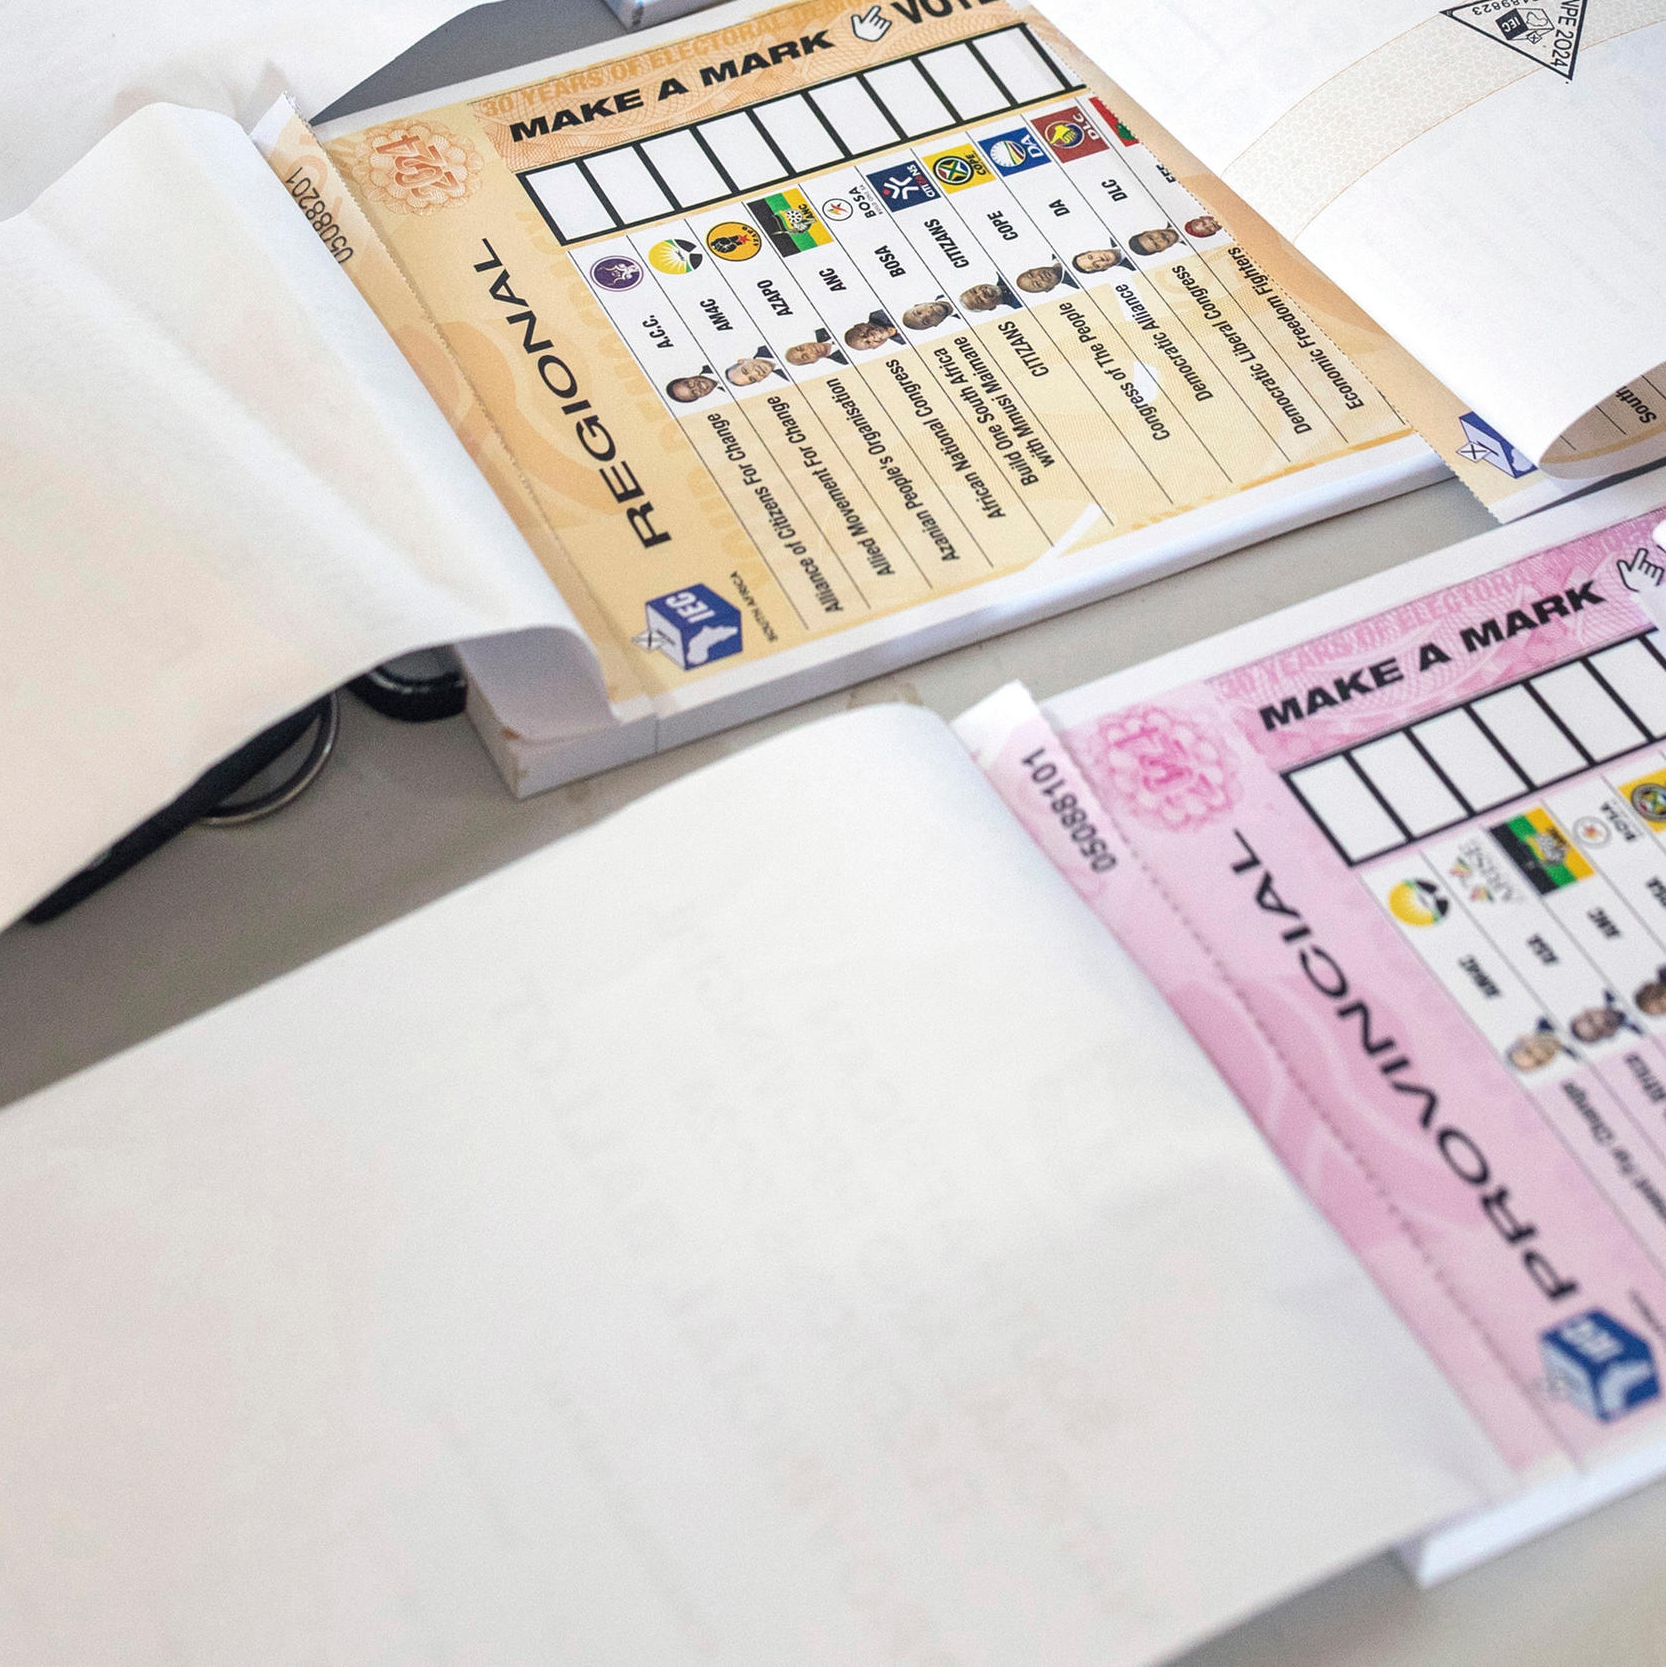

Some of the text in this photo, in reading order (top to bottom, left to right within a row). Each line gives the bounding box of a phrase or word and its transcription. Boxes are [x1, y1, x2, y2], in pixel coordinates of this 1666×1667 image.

[1501, 16, 1521, 32] IEC
[1550, 29, 1574, 67] 2024
[509, 29, 835, 142] MAKE A MARK
[1020, 135, 1043, 159] DA
[1071, 112, 1100, 142] DLC
[964, 153, 987, 175] COPE
[1101, 178, 1128, 202] DLC
[285, 166, 353, 264] 05088201
[849, 187, 876, 219] BOSA
[986, 210, 1019, 242] COPE
[1047, 198, 1070, 218] DA
[874, 245, 906, 278] BOSA
[924, 217, 970, 269] CITIZANS
[756, 279, 794, 317] AZAPO
[818, 268, 847, 292] ANC
[641, 314, 674, 349] A.C.C.
[699, 298, 734, 332] AM4C
[1114, 283, 1213, 402] Democratic Alliance
[1227, 246, 1364, 410] Economic Freedom Fighters
[998, 320, 1049, 378] CITIZANS
[1059, 302, 1170, 441] Congress of The People
[1171, 265, 1312, 435] Democratic Liberal Congress
[474, 237, 671, 549] REGIONAL
[933, 348, 1039, 486] Build One South Africa
[954, 336, 1055, 468] with Mmusi Maimane
[885, 358, 1006, 519] African National Congress
[767, 396, 895, 576] Allied Movement For Change
[826, 378, 960, 561] Azanian People's Organisation
[707, 413, 844, 613] Alliance of Citizens For Change
[665, 591, 715, 624] IEC
[1259, 658, 1404, 731] MAKE
[1418, 642, 1452, 672] A
[1459, 579, 1607, 654] MARK
[1021, 746, 1116, 874] 05088101
[1232, 828, 1580, 1301] PROVINCIAL
